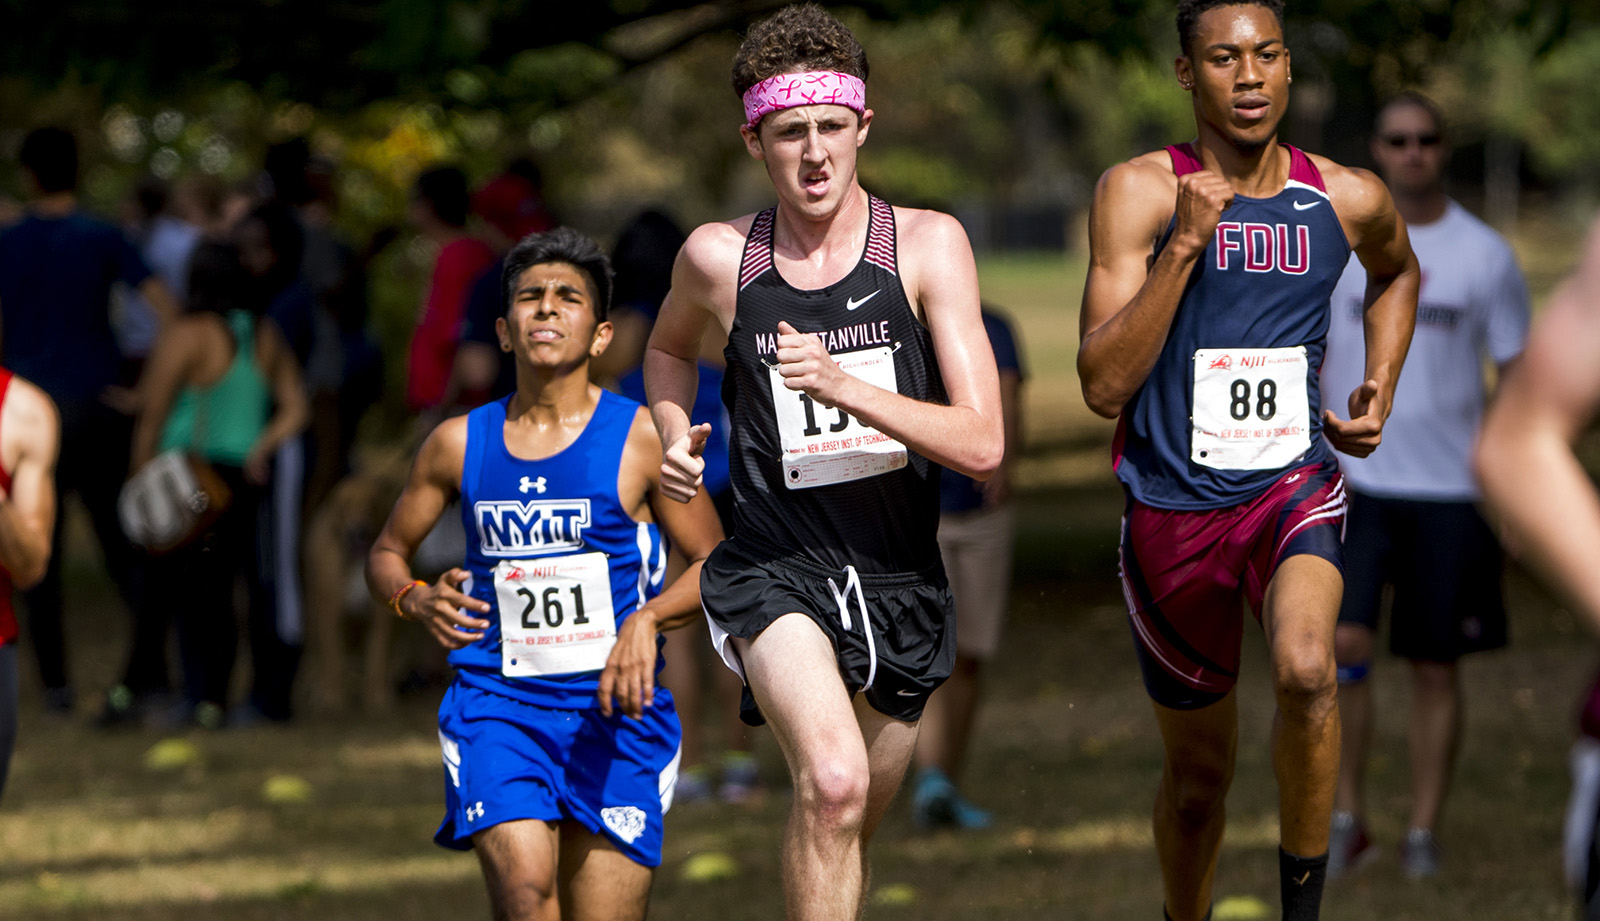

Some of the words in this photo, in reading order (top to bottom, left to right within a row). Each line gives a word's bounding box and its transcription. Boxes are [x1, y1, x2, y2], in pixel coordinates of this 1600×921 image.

[1216, 221, 1310, 275] FDU
[1240, 355, 1267, 369] NJIT
[1230, 378, 1277, 421] 88
[807, 443, 819, 454] NEW
[821, 440, 840, 452] JERSEY
[855, 436, 862, 447] OF
[533, 566, 557, 578] NJIT
[516, 583, 590, 629] 261
